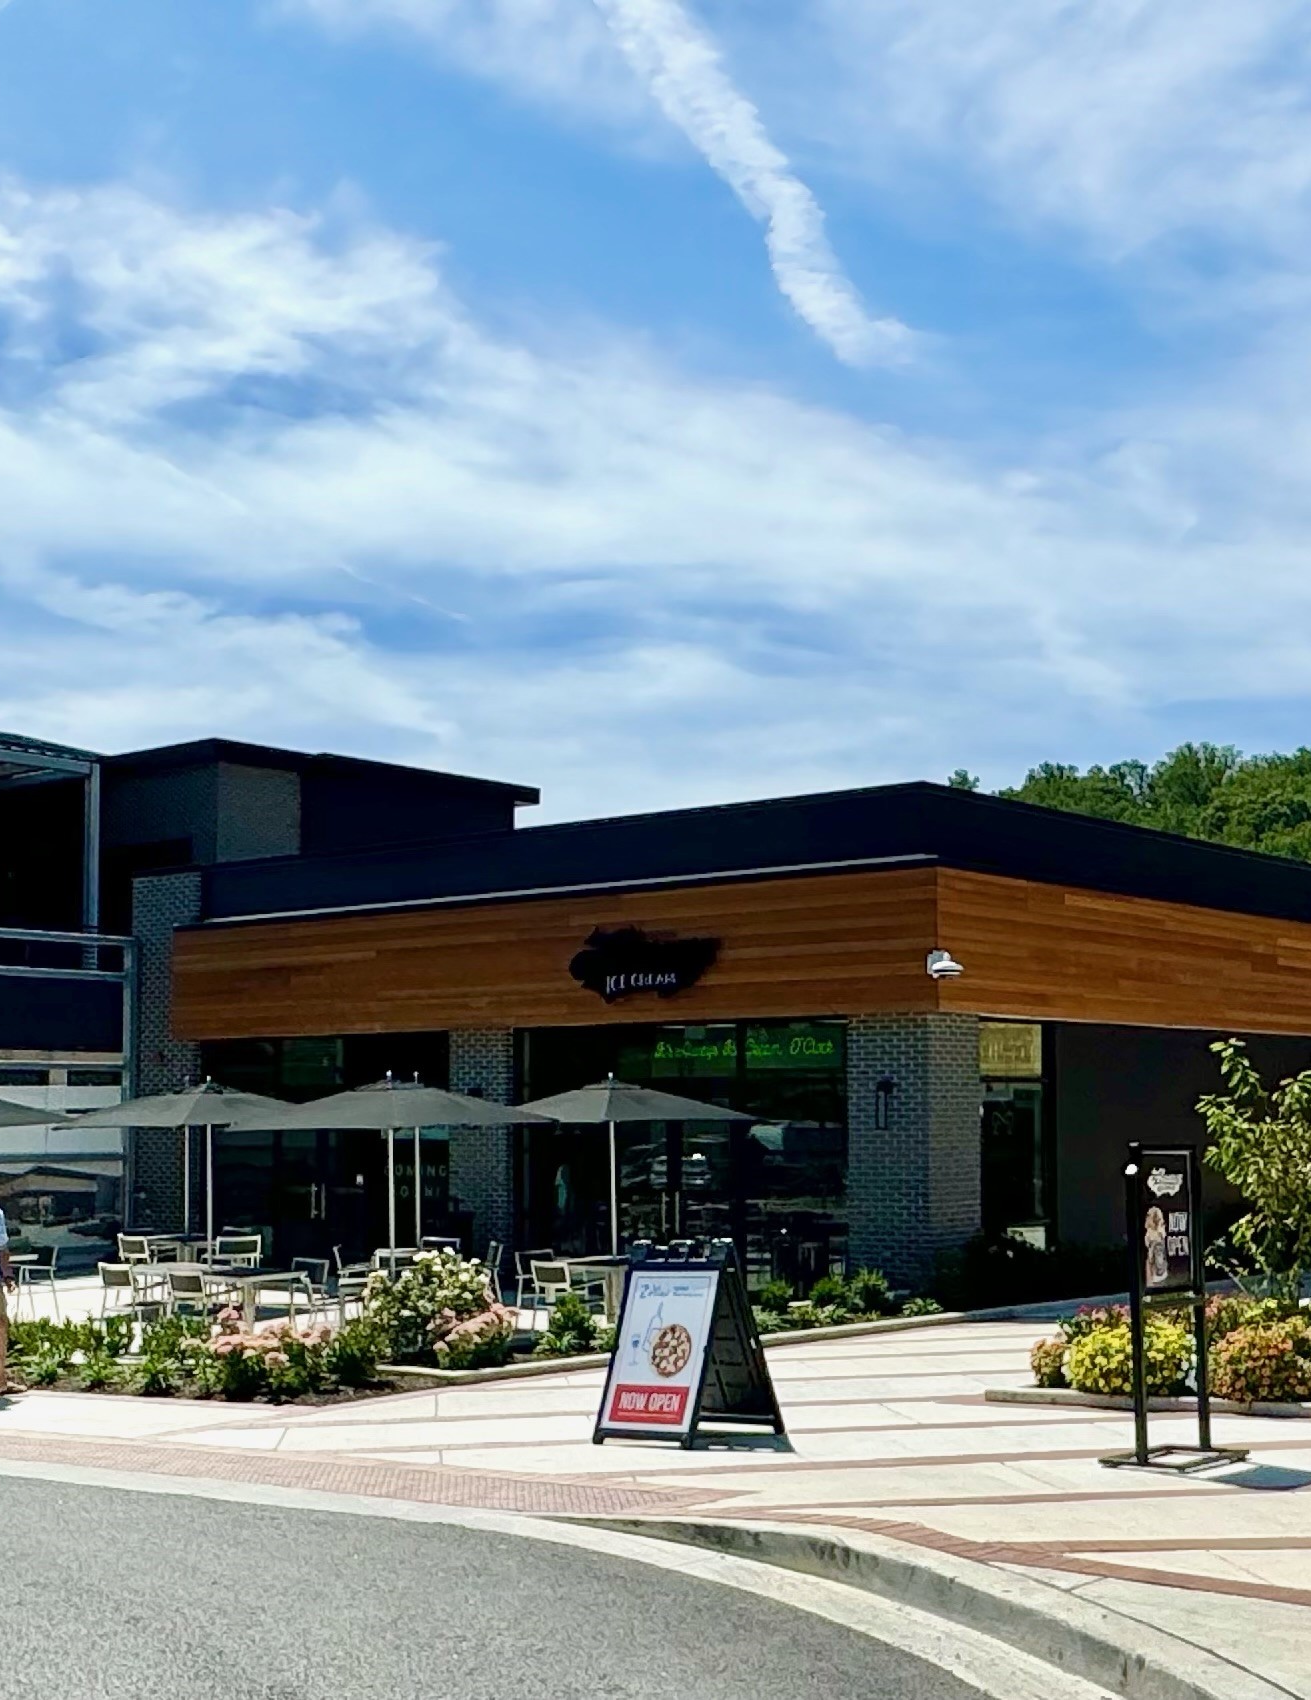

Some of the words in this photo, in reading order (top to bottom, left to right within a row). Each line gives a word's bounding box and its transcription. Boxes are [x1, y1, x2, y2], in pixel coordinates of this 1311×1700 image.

[1168, 1211, 1188, 1232] NOW
[617, 1391, 648, 1410] NOW
[648, 1393, 682, 1412] OPEN
